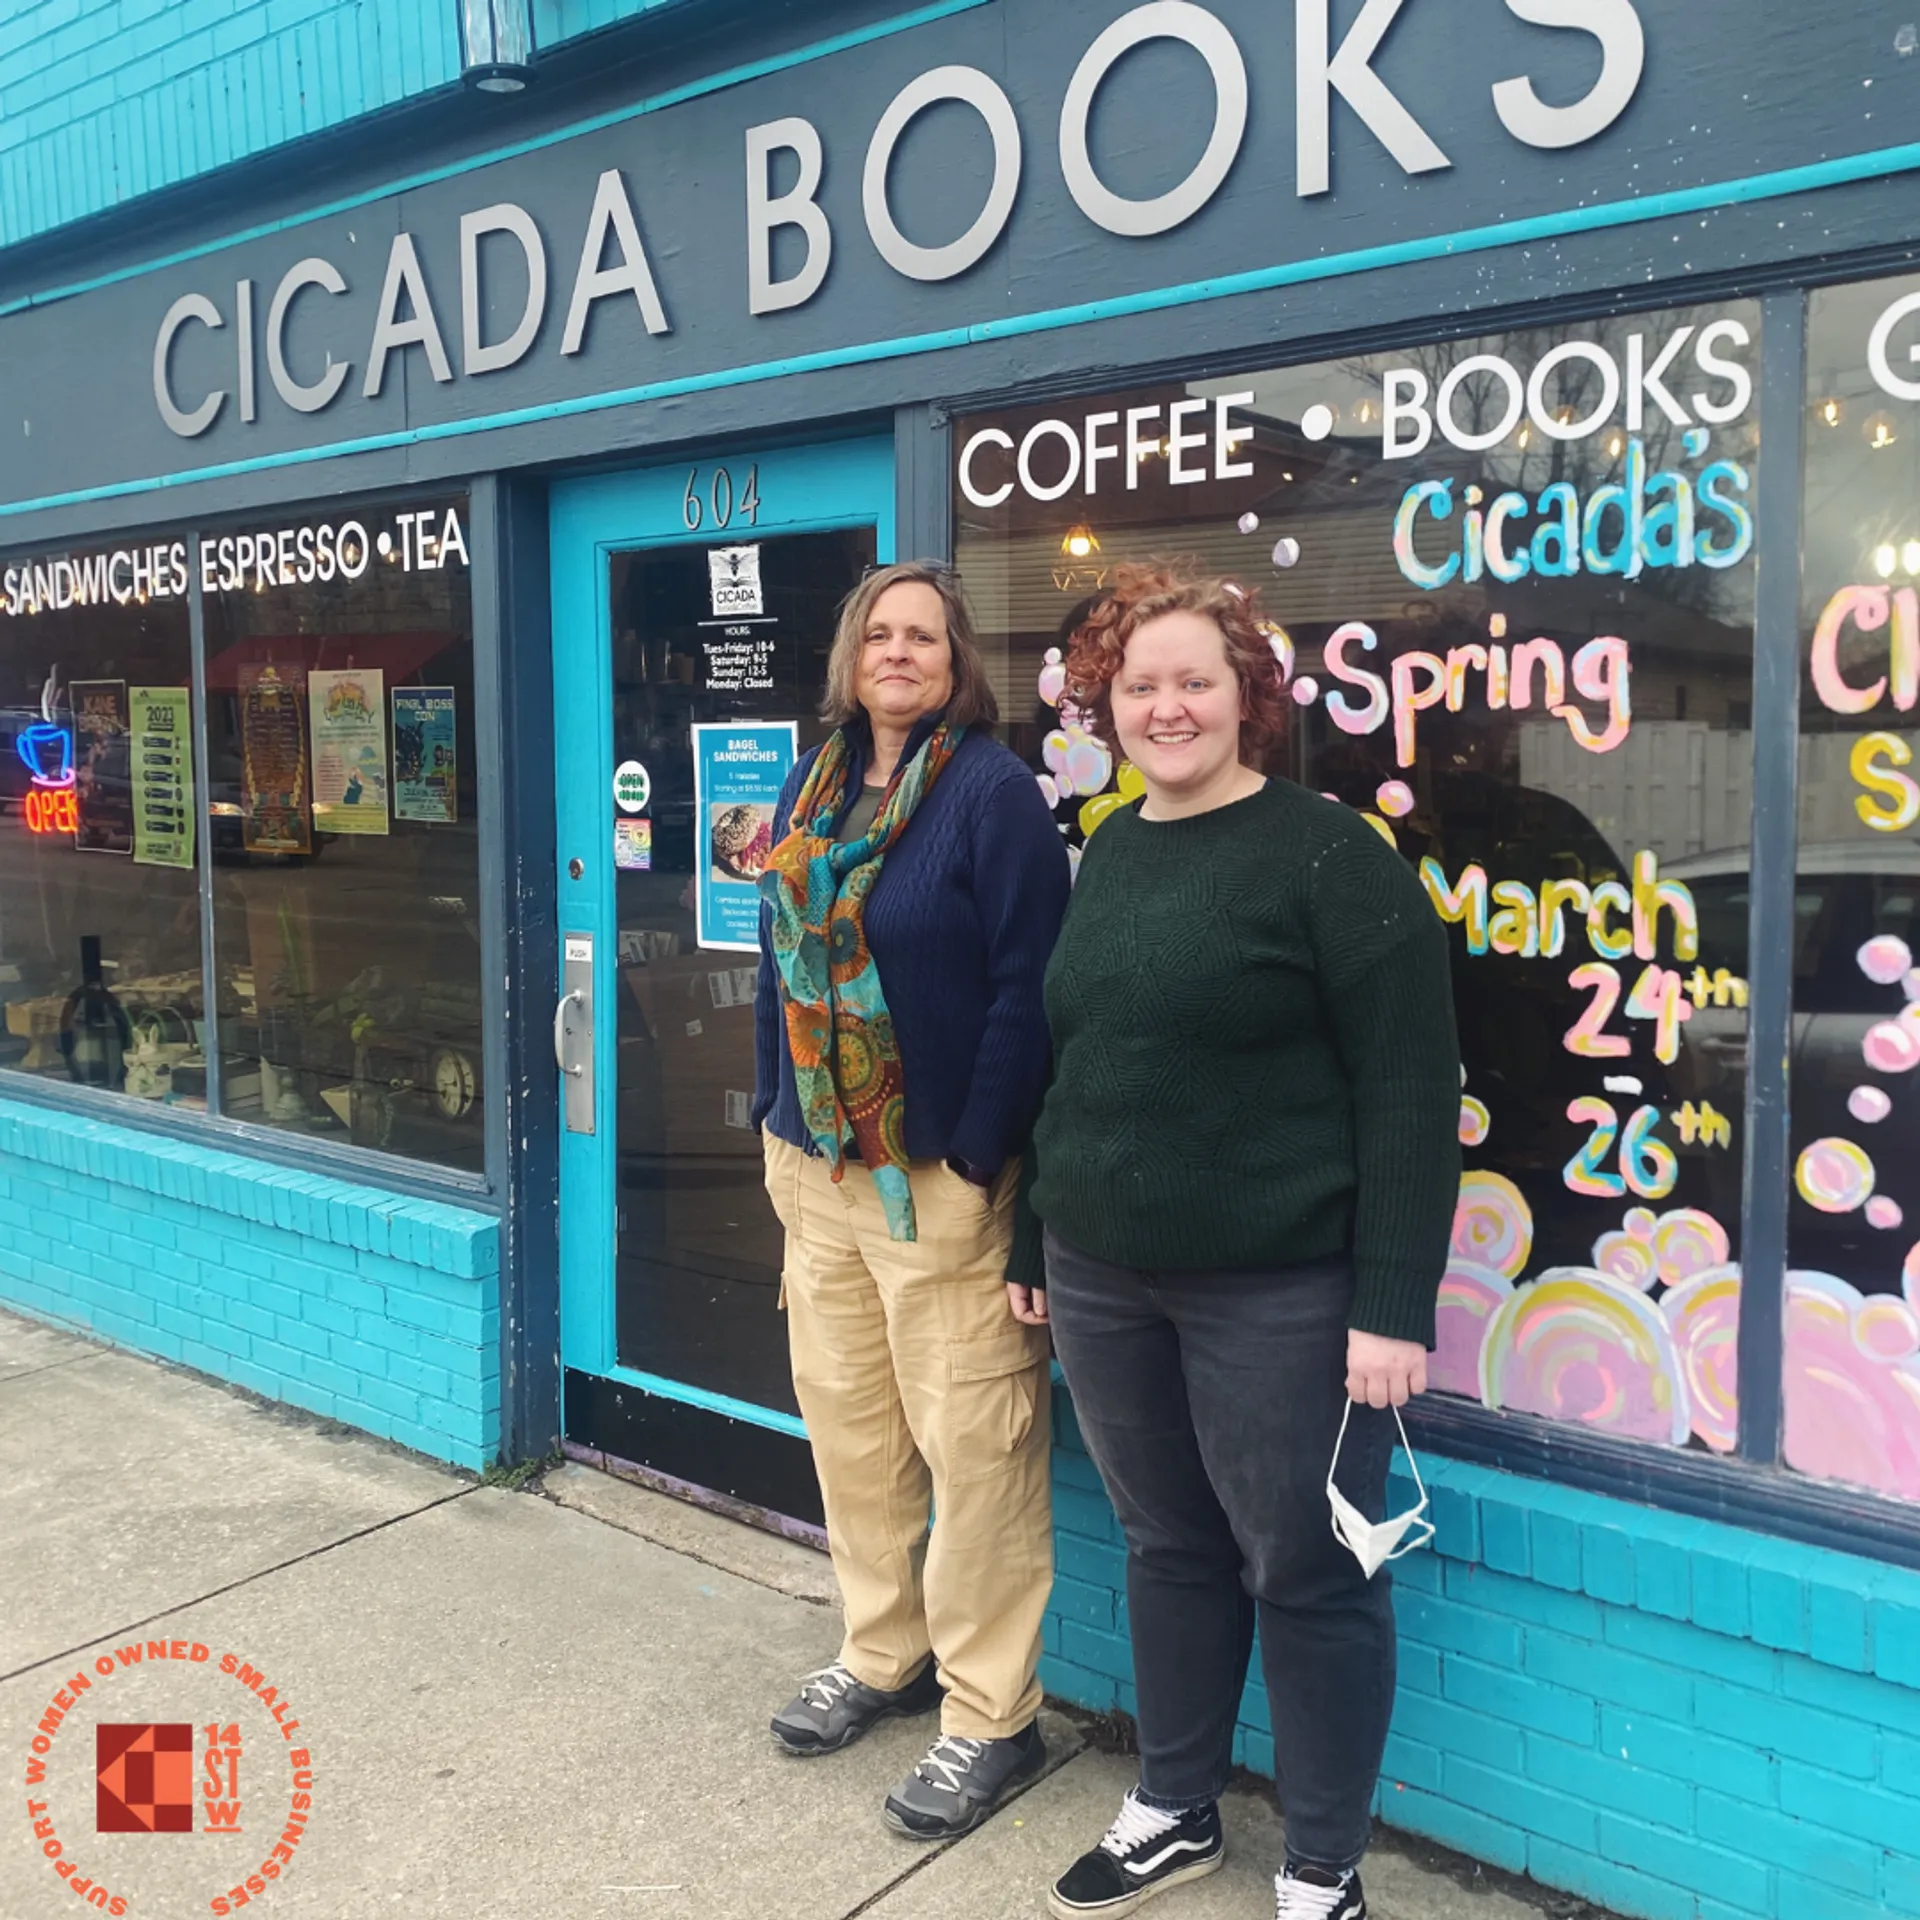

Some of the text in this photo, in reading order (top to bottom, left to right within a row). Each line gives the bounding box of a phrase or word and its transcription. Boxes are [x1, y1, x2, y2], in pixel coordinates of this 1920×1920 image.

[152, 0, 1646, 438] CICADA BOOKS
[958, 320, 1753, 507] COFFEE BOOKS
[683, 463, 761, 531] 604
[1394, 427, 1753, 589] Cicada's
[4, 508, 469, 616] SANDWICHES ESPRESSO TEA
[716, 589, 756, 603] CICADA
[705, 677, 774, 691] Monday: Closed
[710, 655, 752, 668] Saturday:
[712, 665, 767, 679] Sunday: 12-5
[1324, 613, 1631, 769] Spring
[713, 750, 778, 762] SANDWICHES
[728, 739, 759, 750] BAGEL
[25, 790, 78, 833] OPEN
[1420, 849, 1698, 960] March
[1563, 960, 1749, 1065] 24th
[1563, 1096, 1731, 1199] 26th
